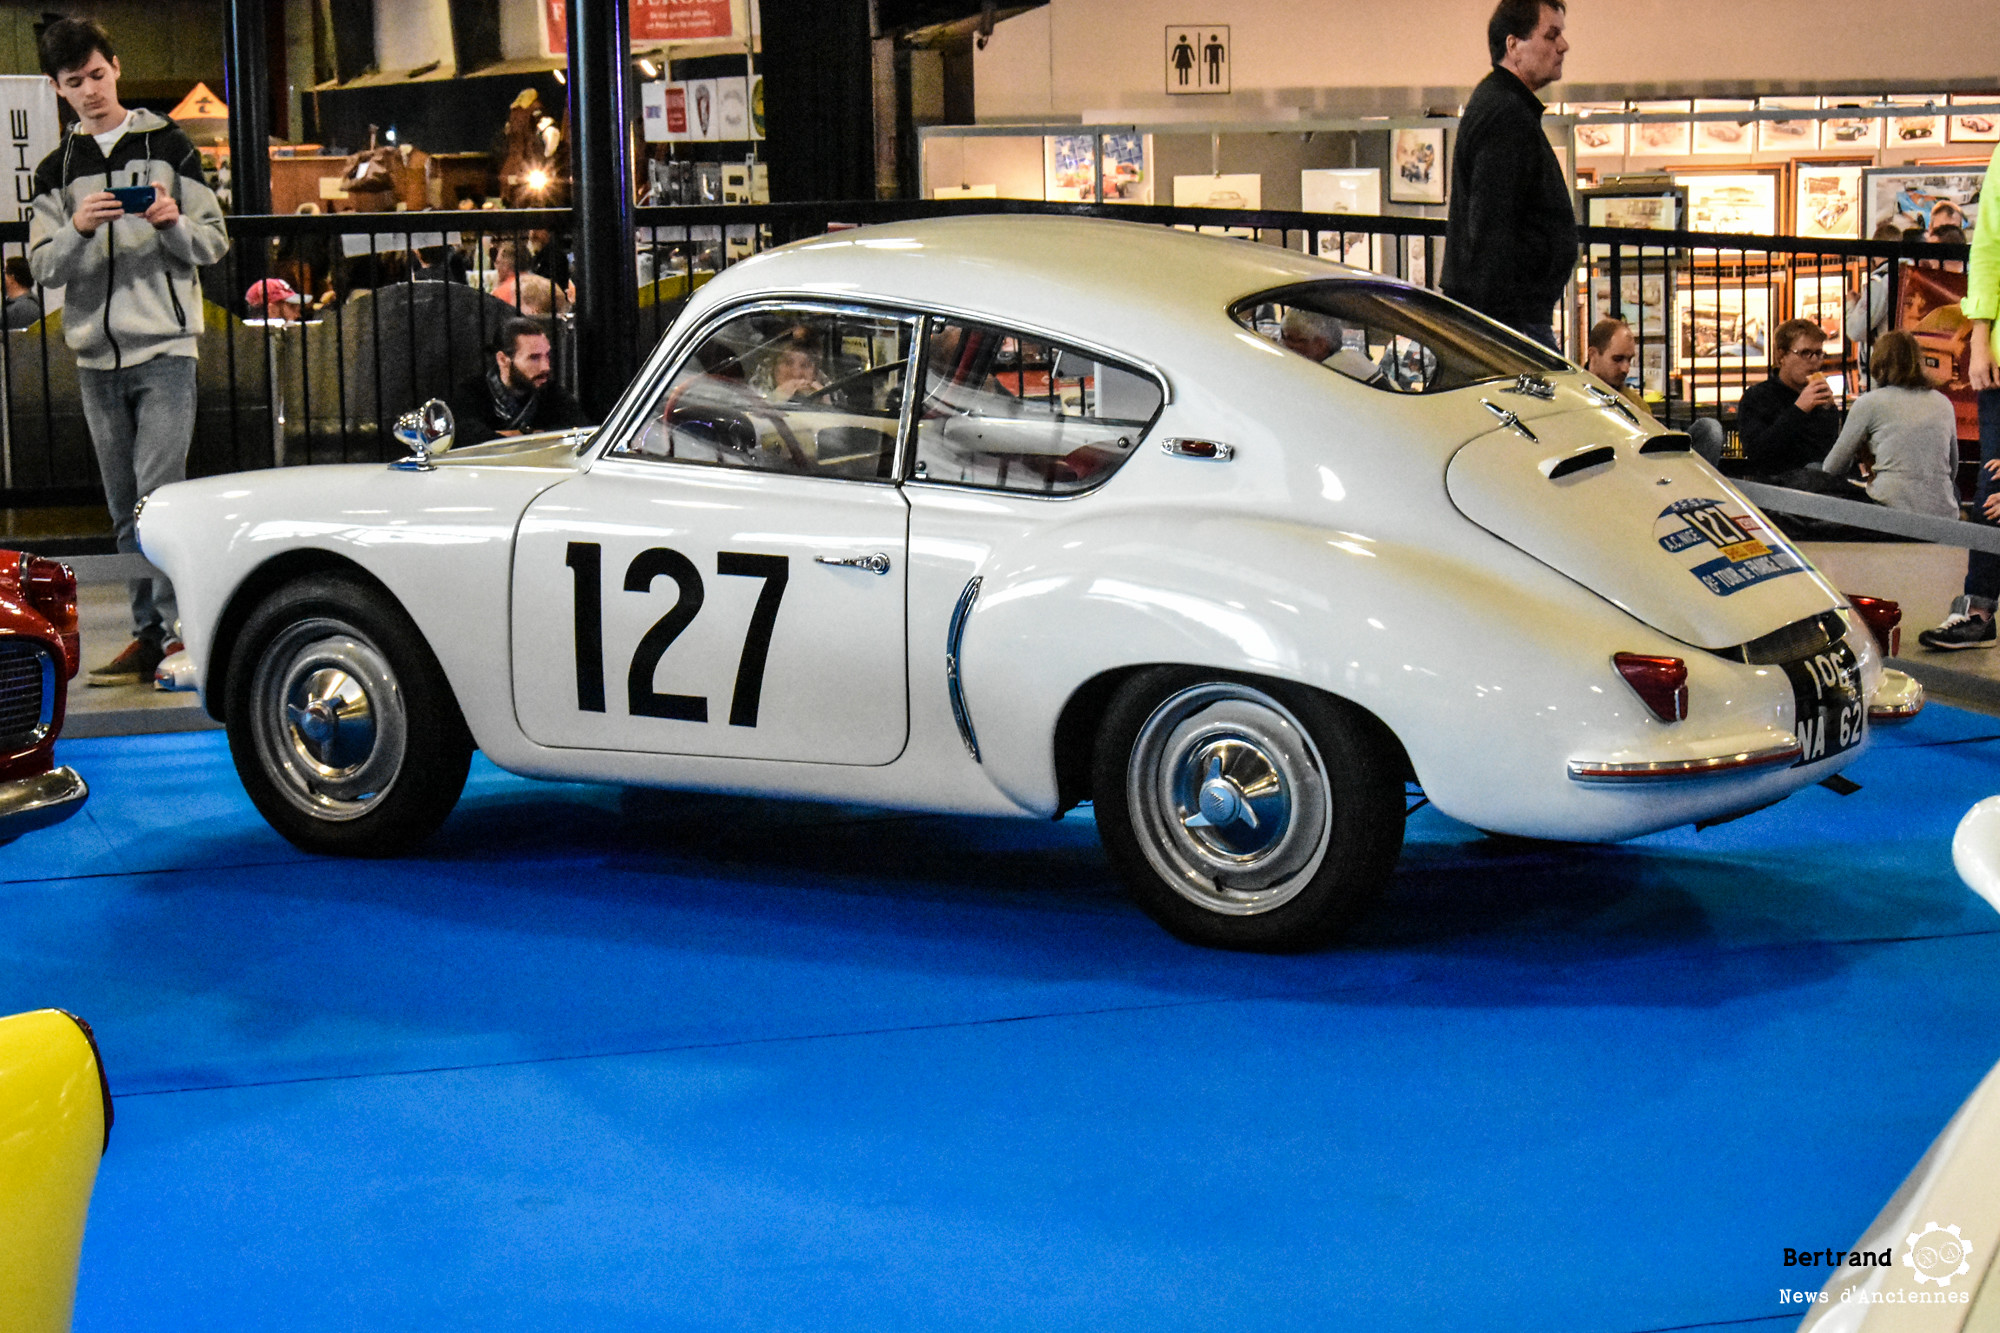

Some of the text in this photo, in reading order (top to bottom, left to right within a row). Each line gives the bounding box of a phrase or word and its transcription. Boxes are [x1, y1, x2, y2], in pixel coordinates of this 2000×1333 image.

[1682, 506, 1746, 546] 127
[565, 541, 789, 728] 127
[1798, 701, 1862, 761] NA 62
